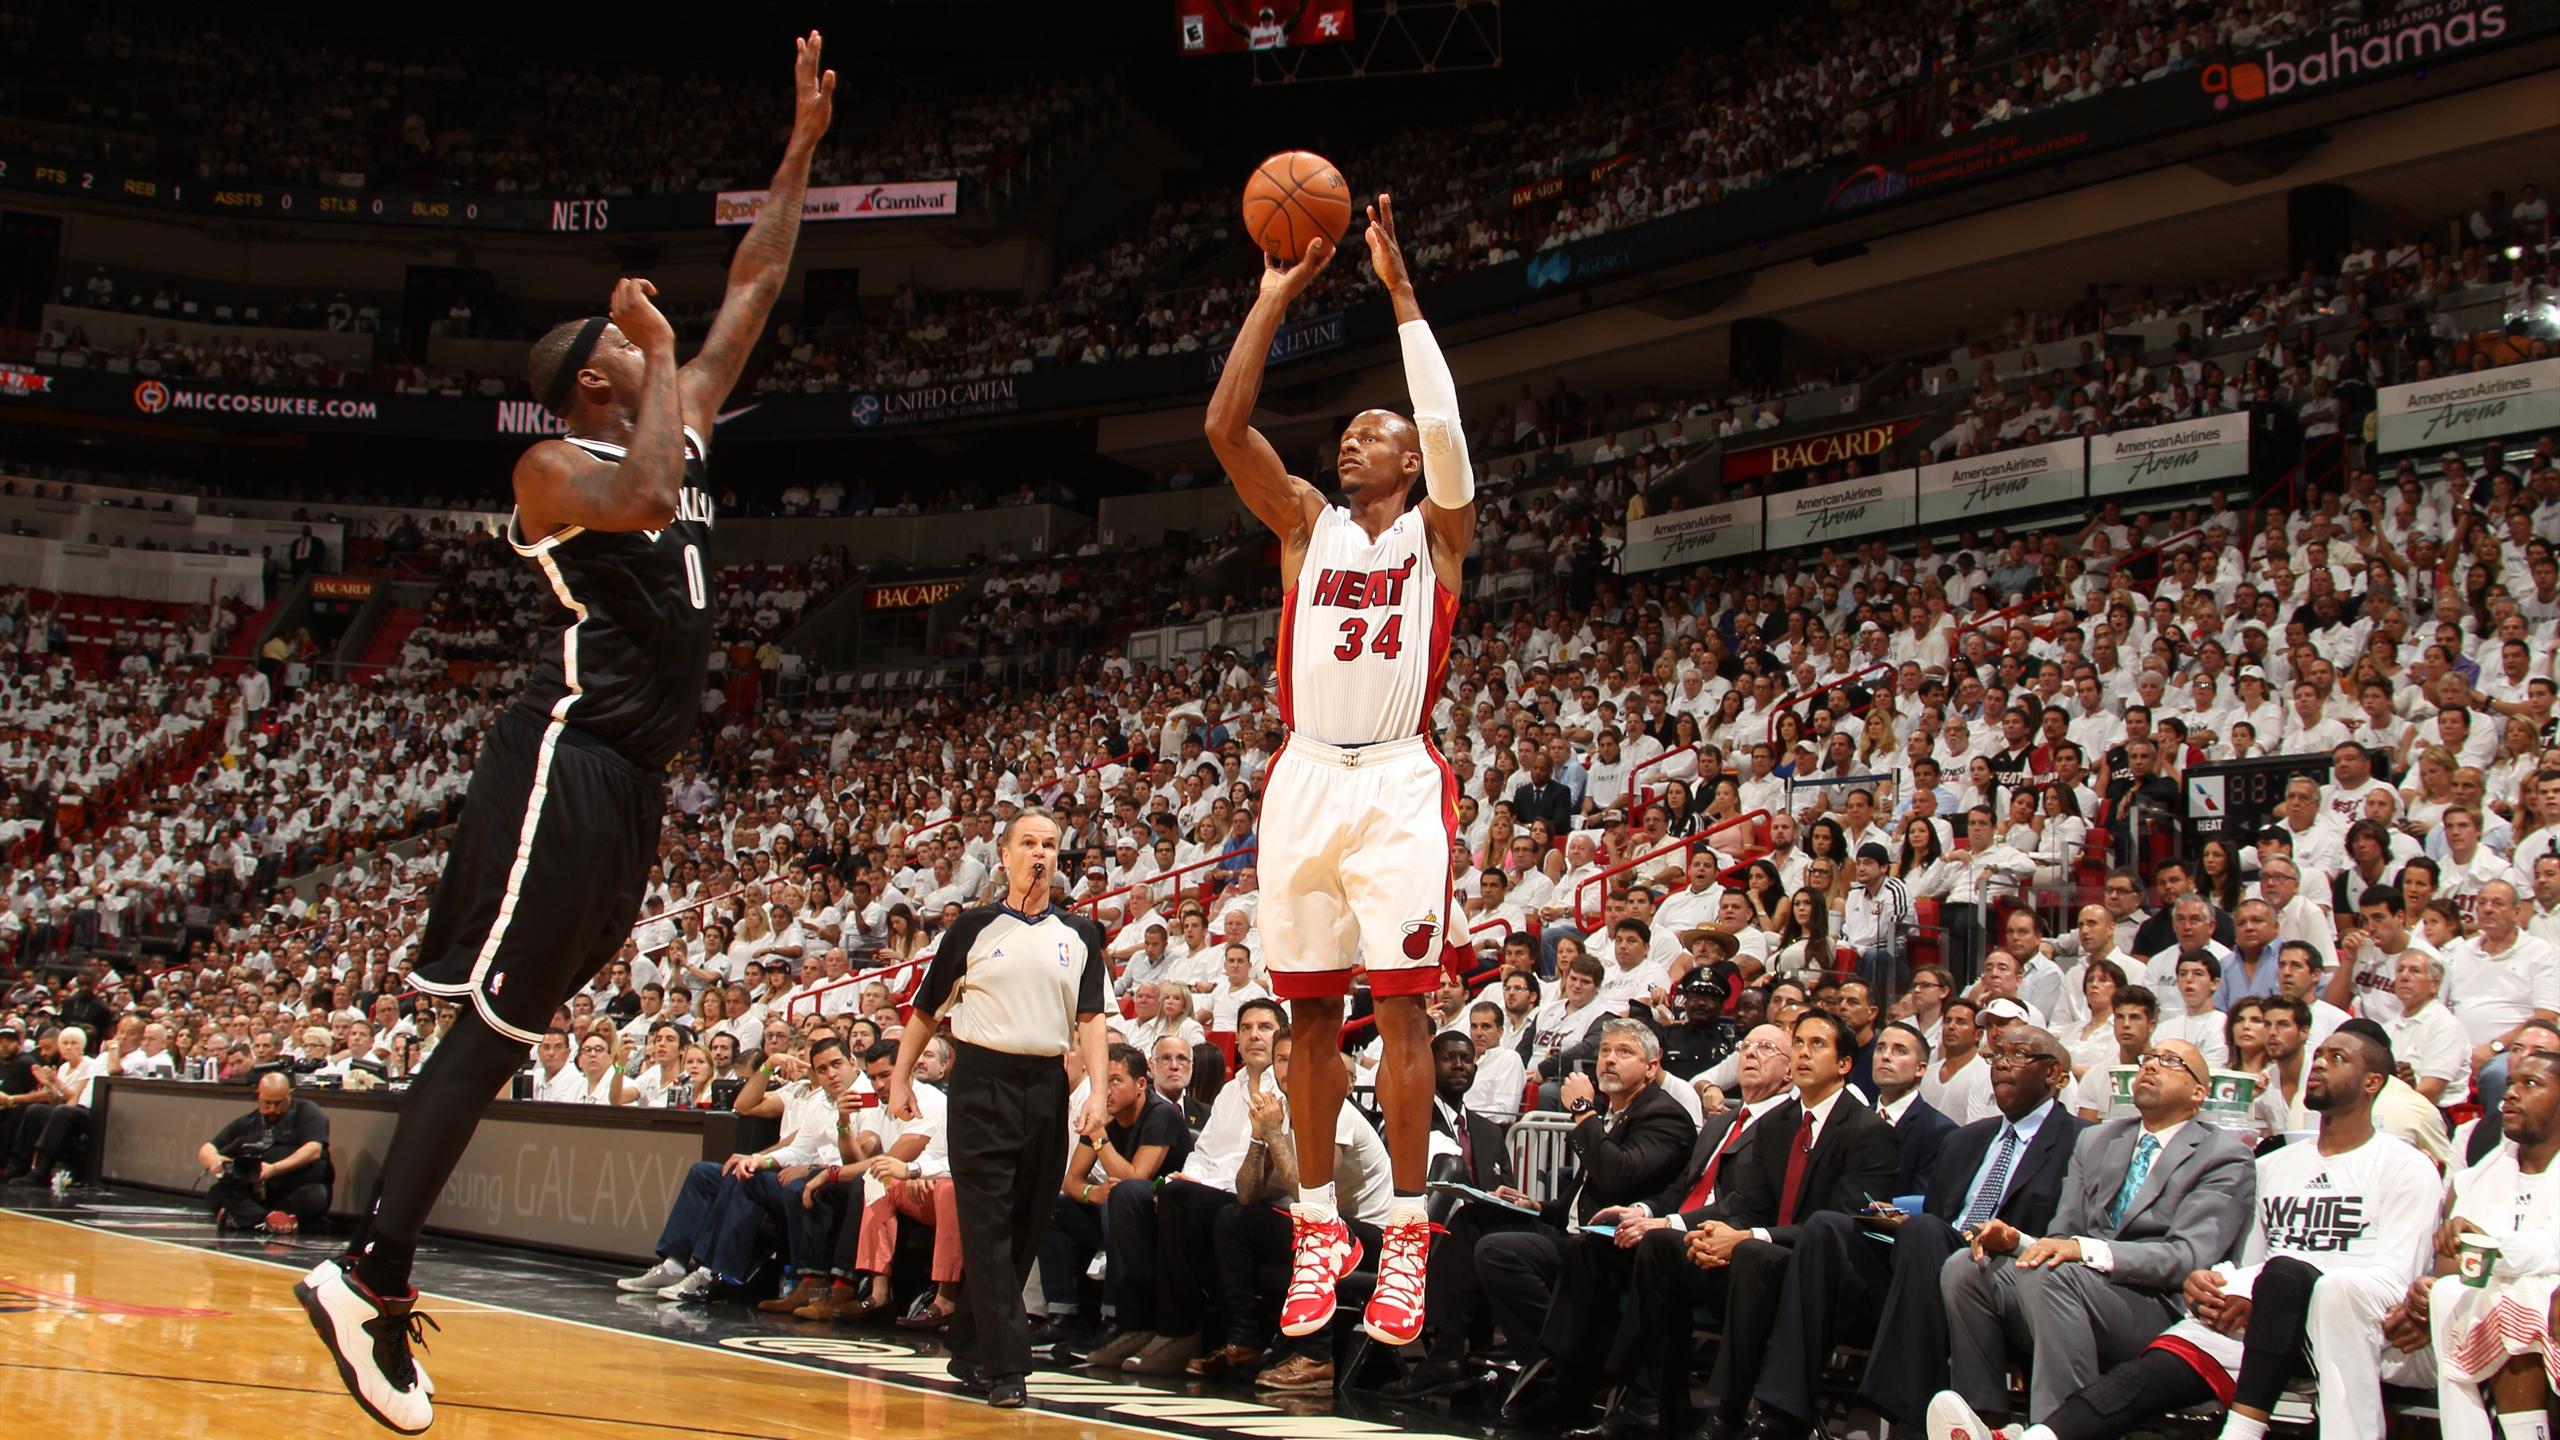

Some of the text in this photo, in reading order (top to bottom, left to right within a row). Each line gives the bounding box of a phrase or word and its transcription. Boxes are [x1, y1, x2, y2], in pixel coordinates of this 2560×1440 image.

[2377, 3, 2444, 32] ISLANDS
[2267, 4, 2507, 95] bahamas
[34, 166, 67, 185] PTS
[80, 171, 94, 190] 2
[123, 178, 157, 198] REB
[172, 185, 181, 201] 1
[213, 191, 264, 209] ASSTS
[281, 193, 292, 210] 0
[319, 196, 358, 213] STLS
[372, 199, 383, 215] 0
[411, 201, 449, 217] BLKS
[466, 203, 478, 220] 0
[875, 193, 946, 211] Carnival
[552, 198, 609, 232] NETS
[172, 390, 379, 419] MICCOSUKEE.COM
[884, 378, 1018, 414] UNITED CAPITAL
[2422, 400, 2509, 440] Arena
[2128, 449, 2200, 485] Arena
[1963, 476, 2031, 511] Arena
[1806, 503, 1867, 538] Arena
[1662, 531, 1718, 562] Arena
[314, 582, 372, 595] BACARDI
[683, 543, 706, 610] 0
[1312, 552, 1417, 610] HEAT
[1333, 614, 1403, 662] 34
[2197, 819, 2223, 832] HEAT
[514, 1142, 685, 1231] GALAXY
[2262, 1195, 2363, 1230] WHITE
